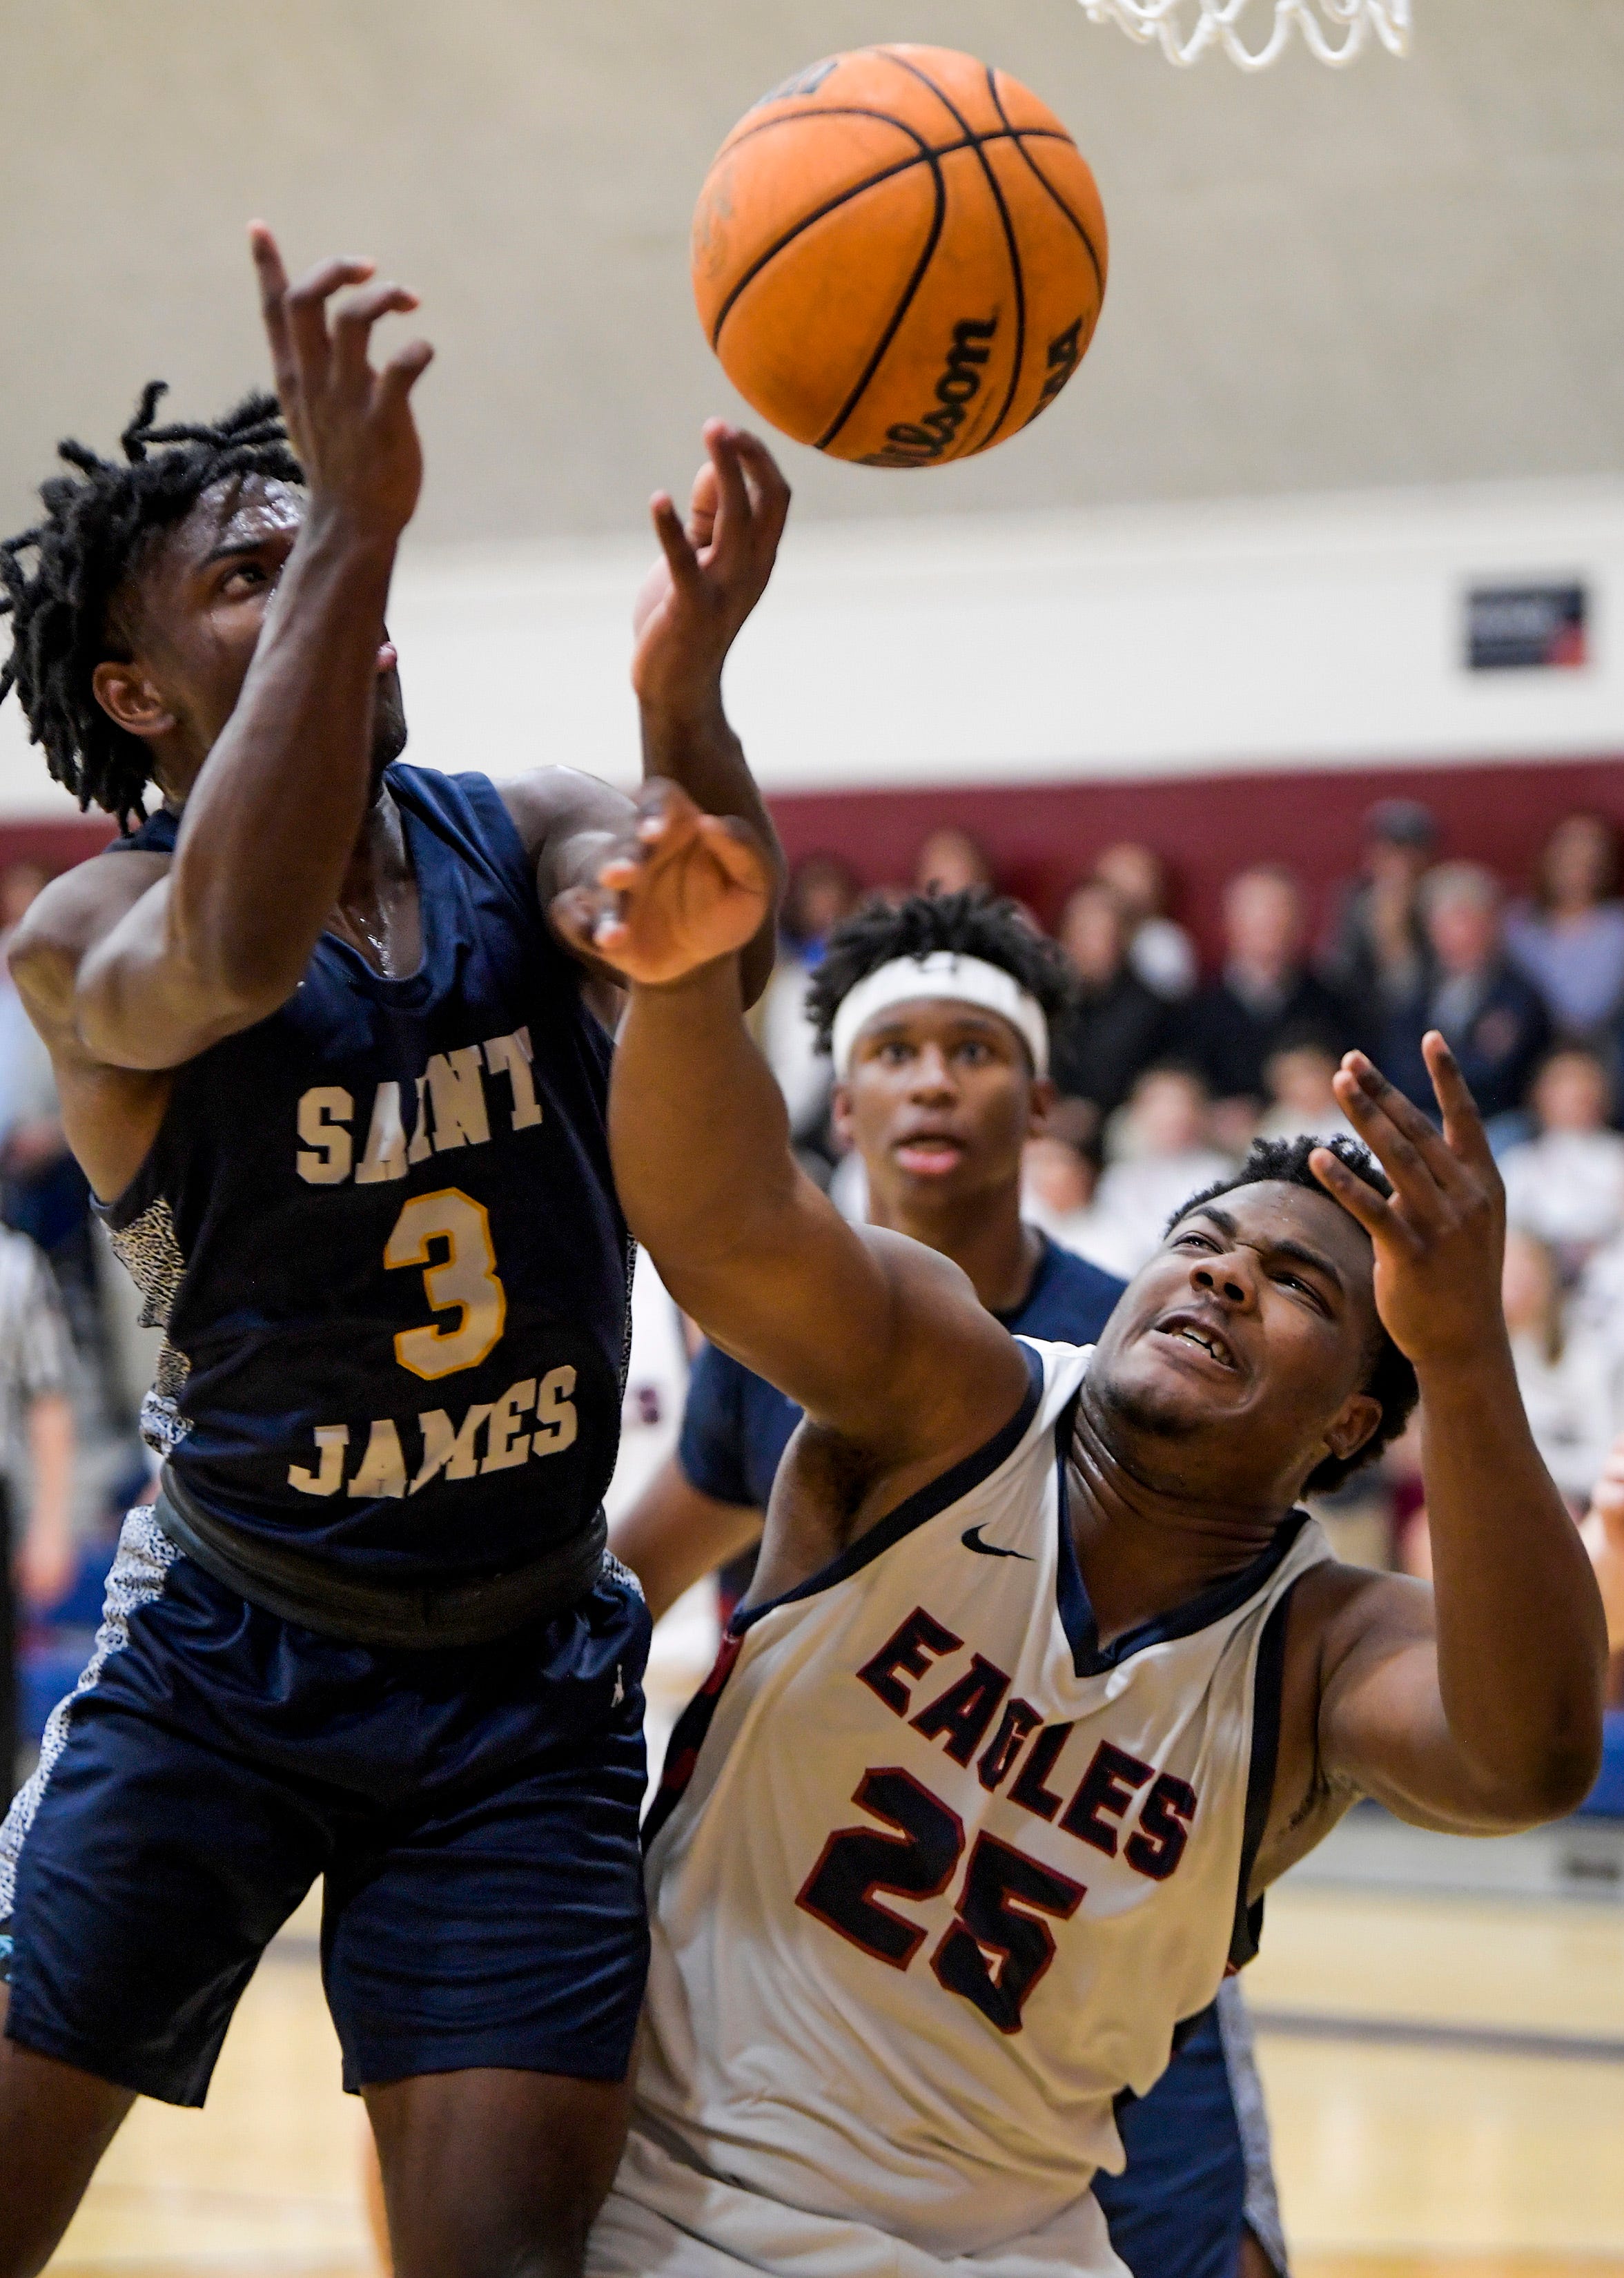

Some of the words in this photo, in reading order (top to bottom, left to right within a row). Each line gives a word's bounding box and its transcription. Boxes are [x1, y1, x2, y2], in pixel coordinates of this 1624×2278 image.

[295, 1026, 542, 1185] SAINT
[383, 1187, 507, 1381] 3
[287, 1365, 577, 1499] JAMES
[856, 1606, 1197, 1881] EAGLES
[795, 1766, 1088, 2034] 25
